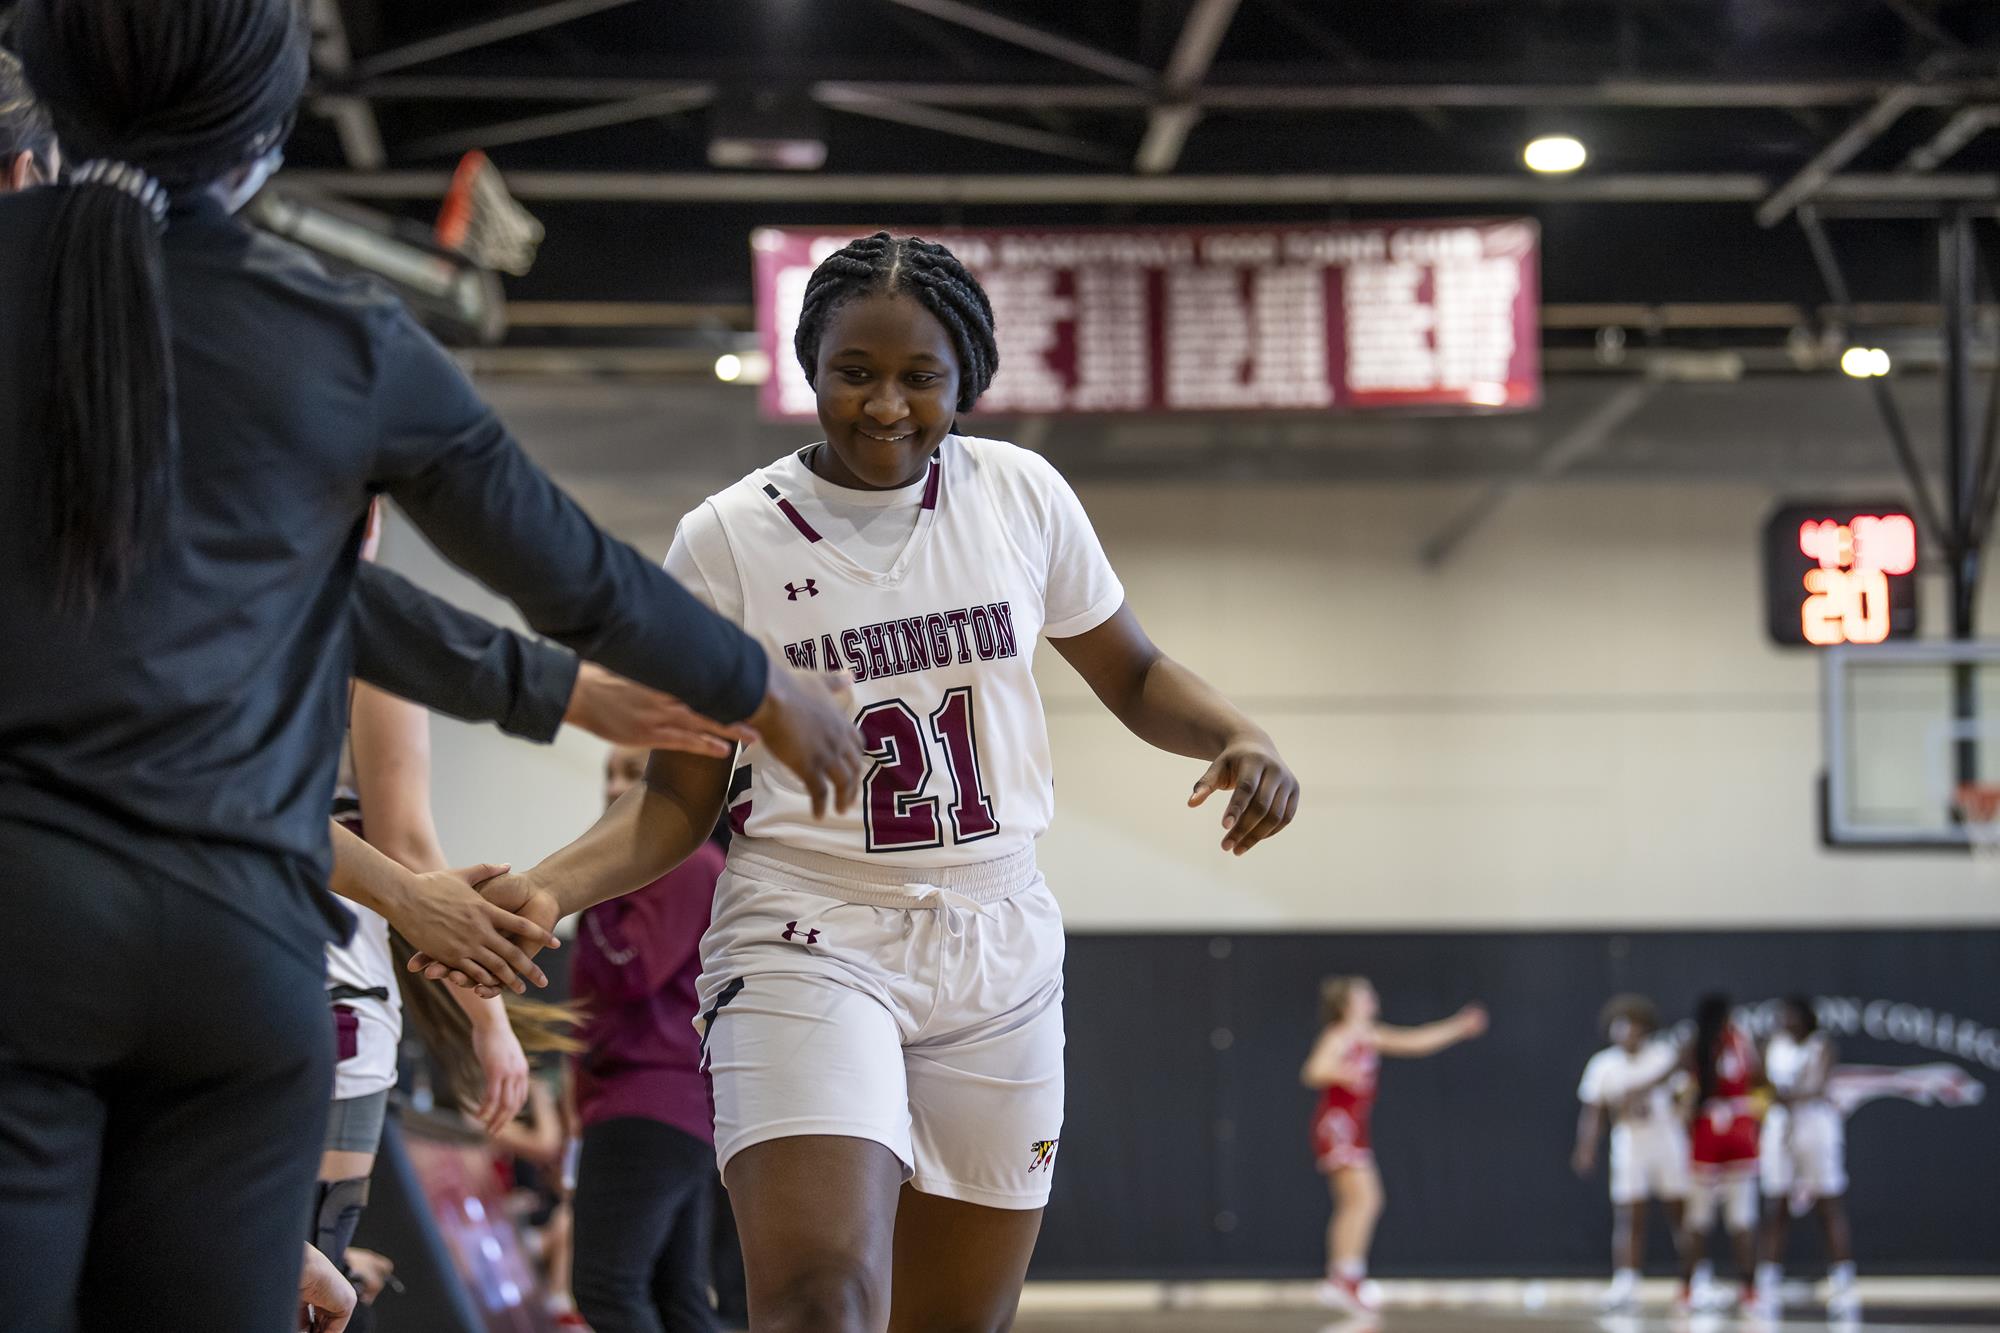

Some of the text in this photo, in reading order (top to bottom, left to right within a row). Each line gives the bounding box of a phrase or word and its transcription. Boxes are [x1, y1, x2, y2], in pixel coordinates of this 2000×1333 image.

[784, 602, 1018, 683] WASHINGTON
[1802, 568, 1889, 645] 20
[853, 686, 1000, 853] 21
